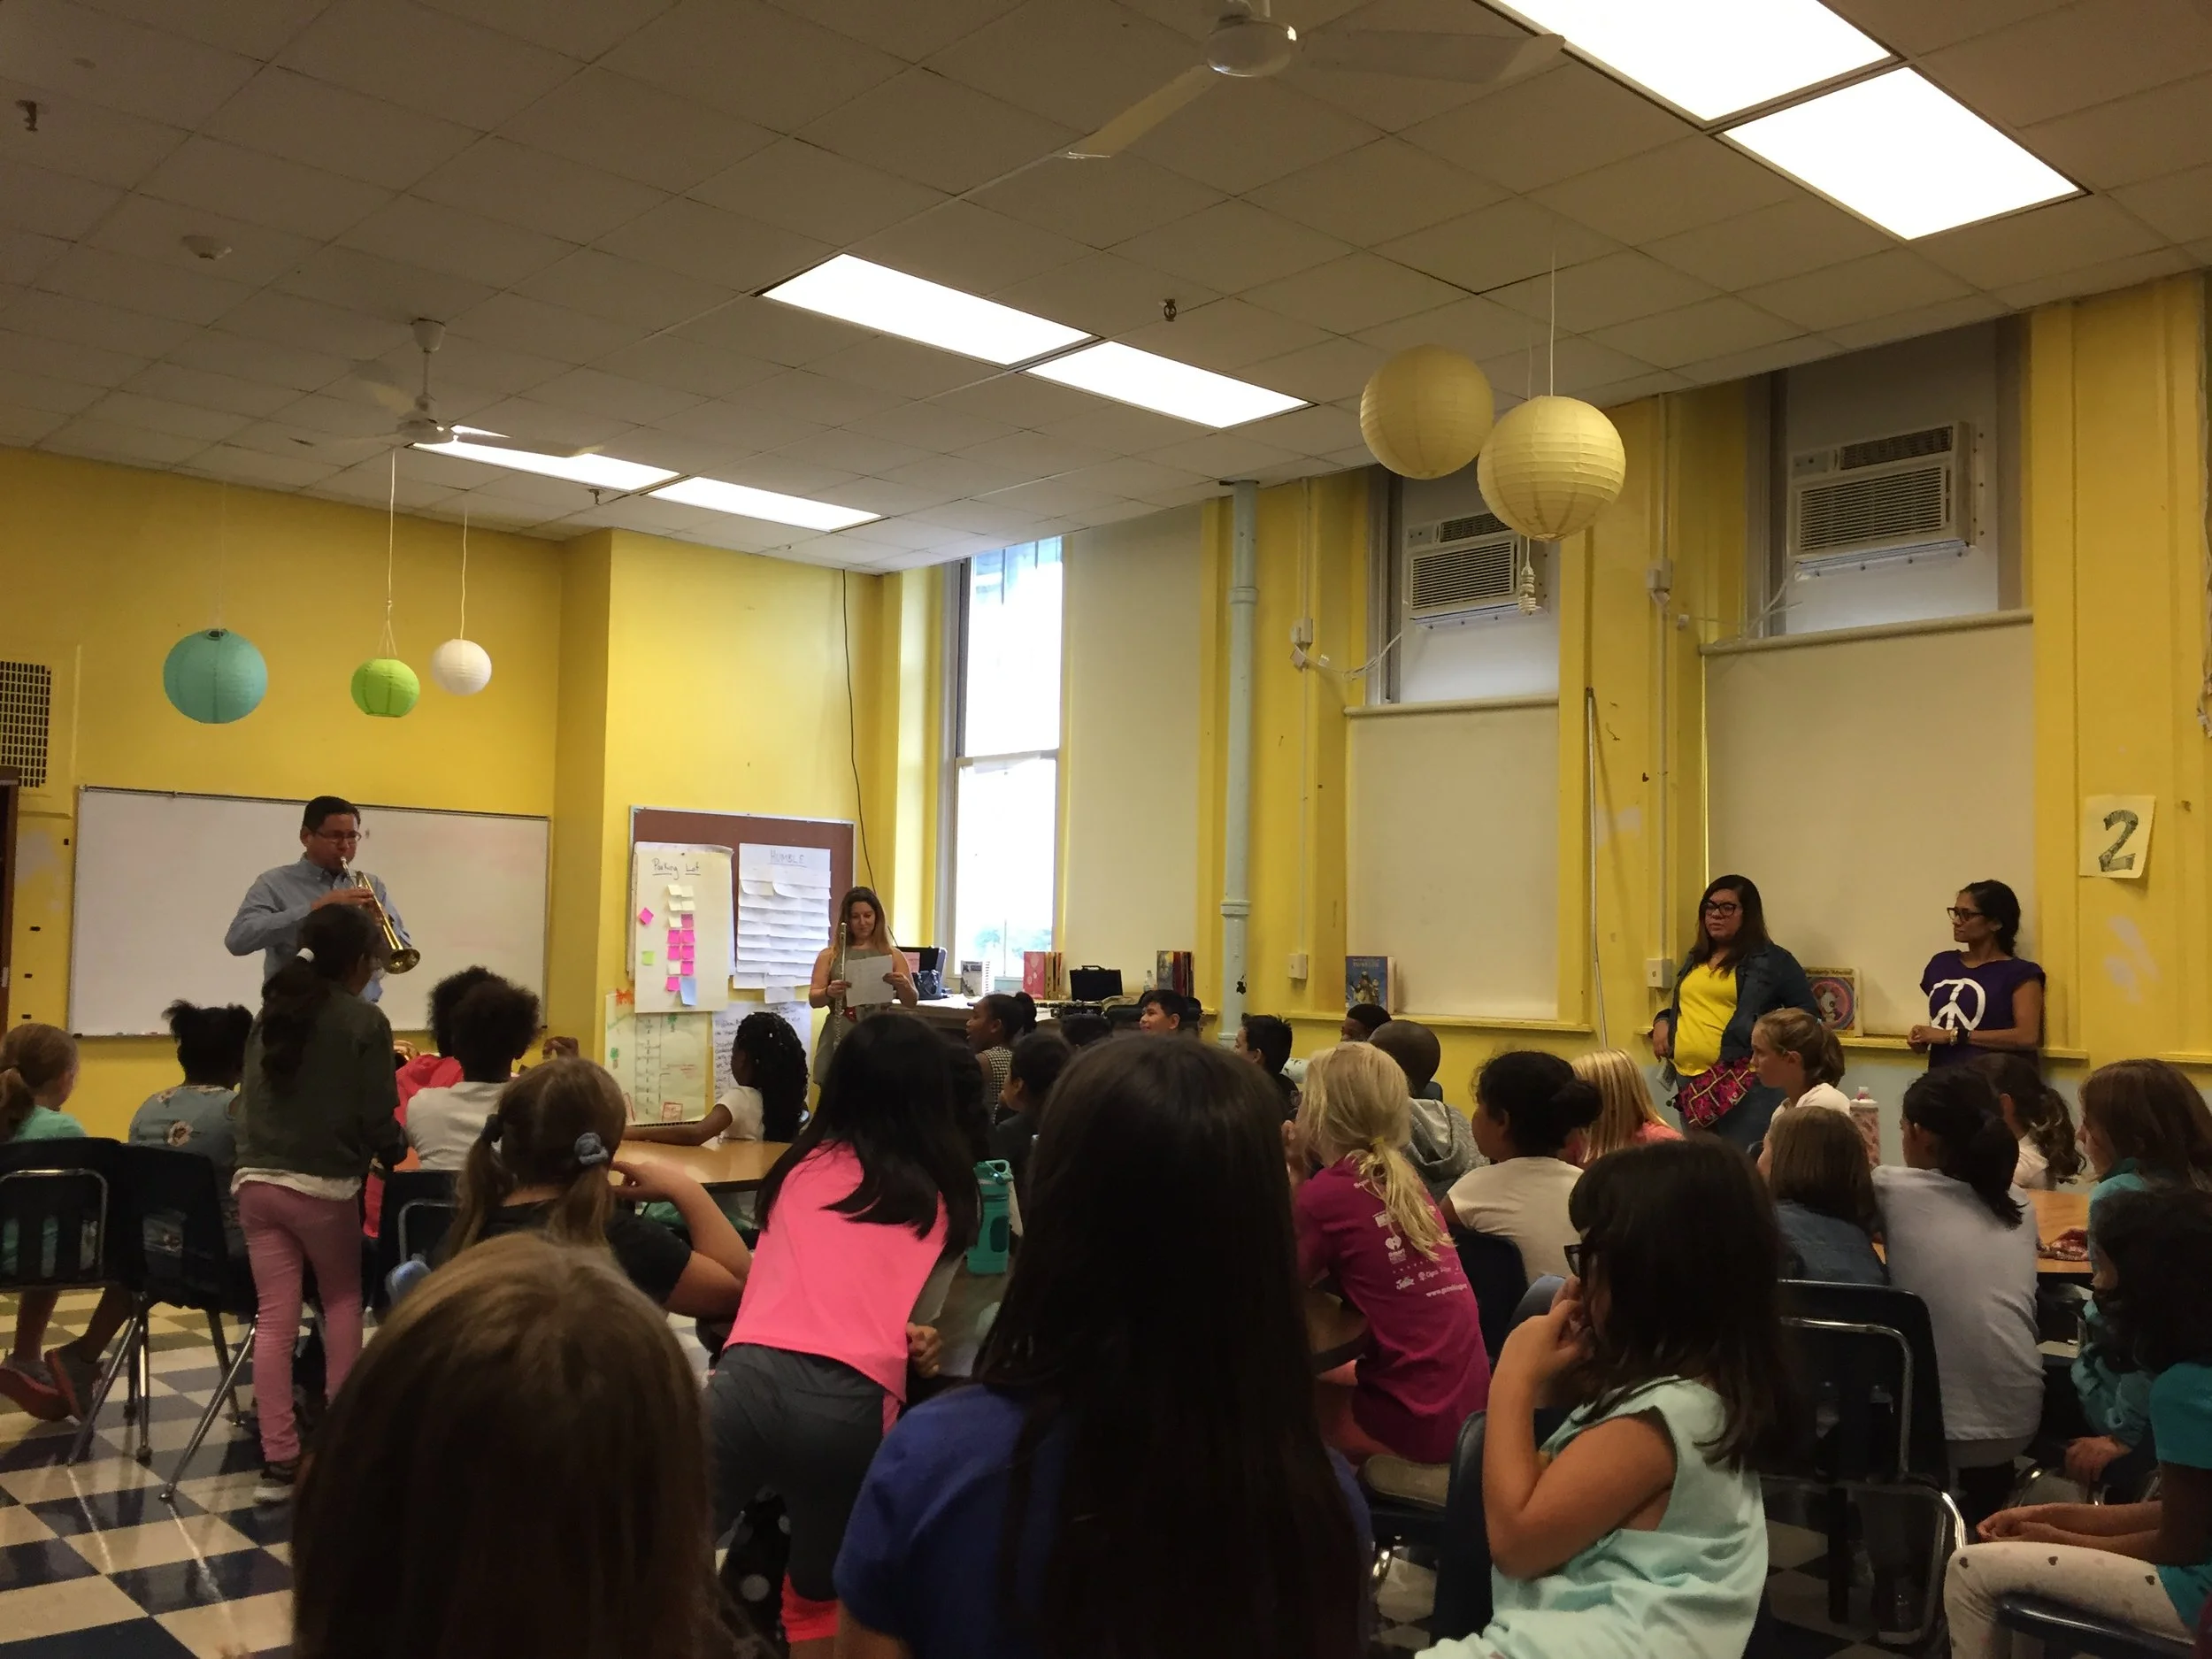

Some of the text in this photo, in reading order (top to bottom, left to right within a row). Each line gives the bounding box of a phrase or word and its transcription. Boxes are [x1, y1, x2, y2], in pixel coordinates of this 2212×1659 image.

[2098, 810, 2139, 872] 2
[651, 857, 700, 880] Parking Lot
